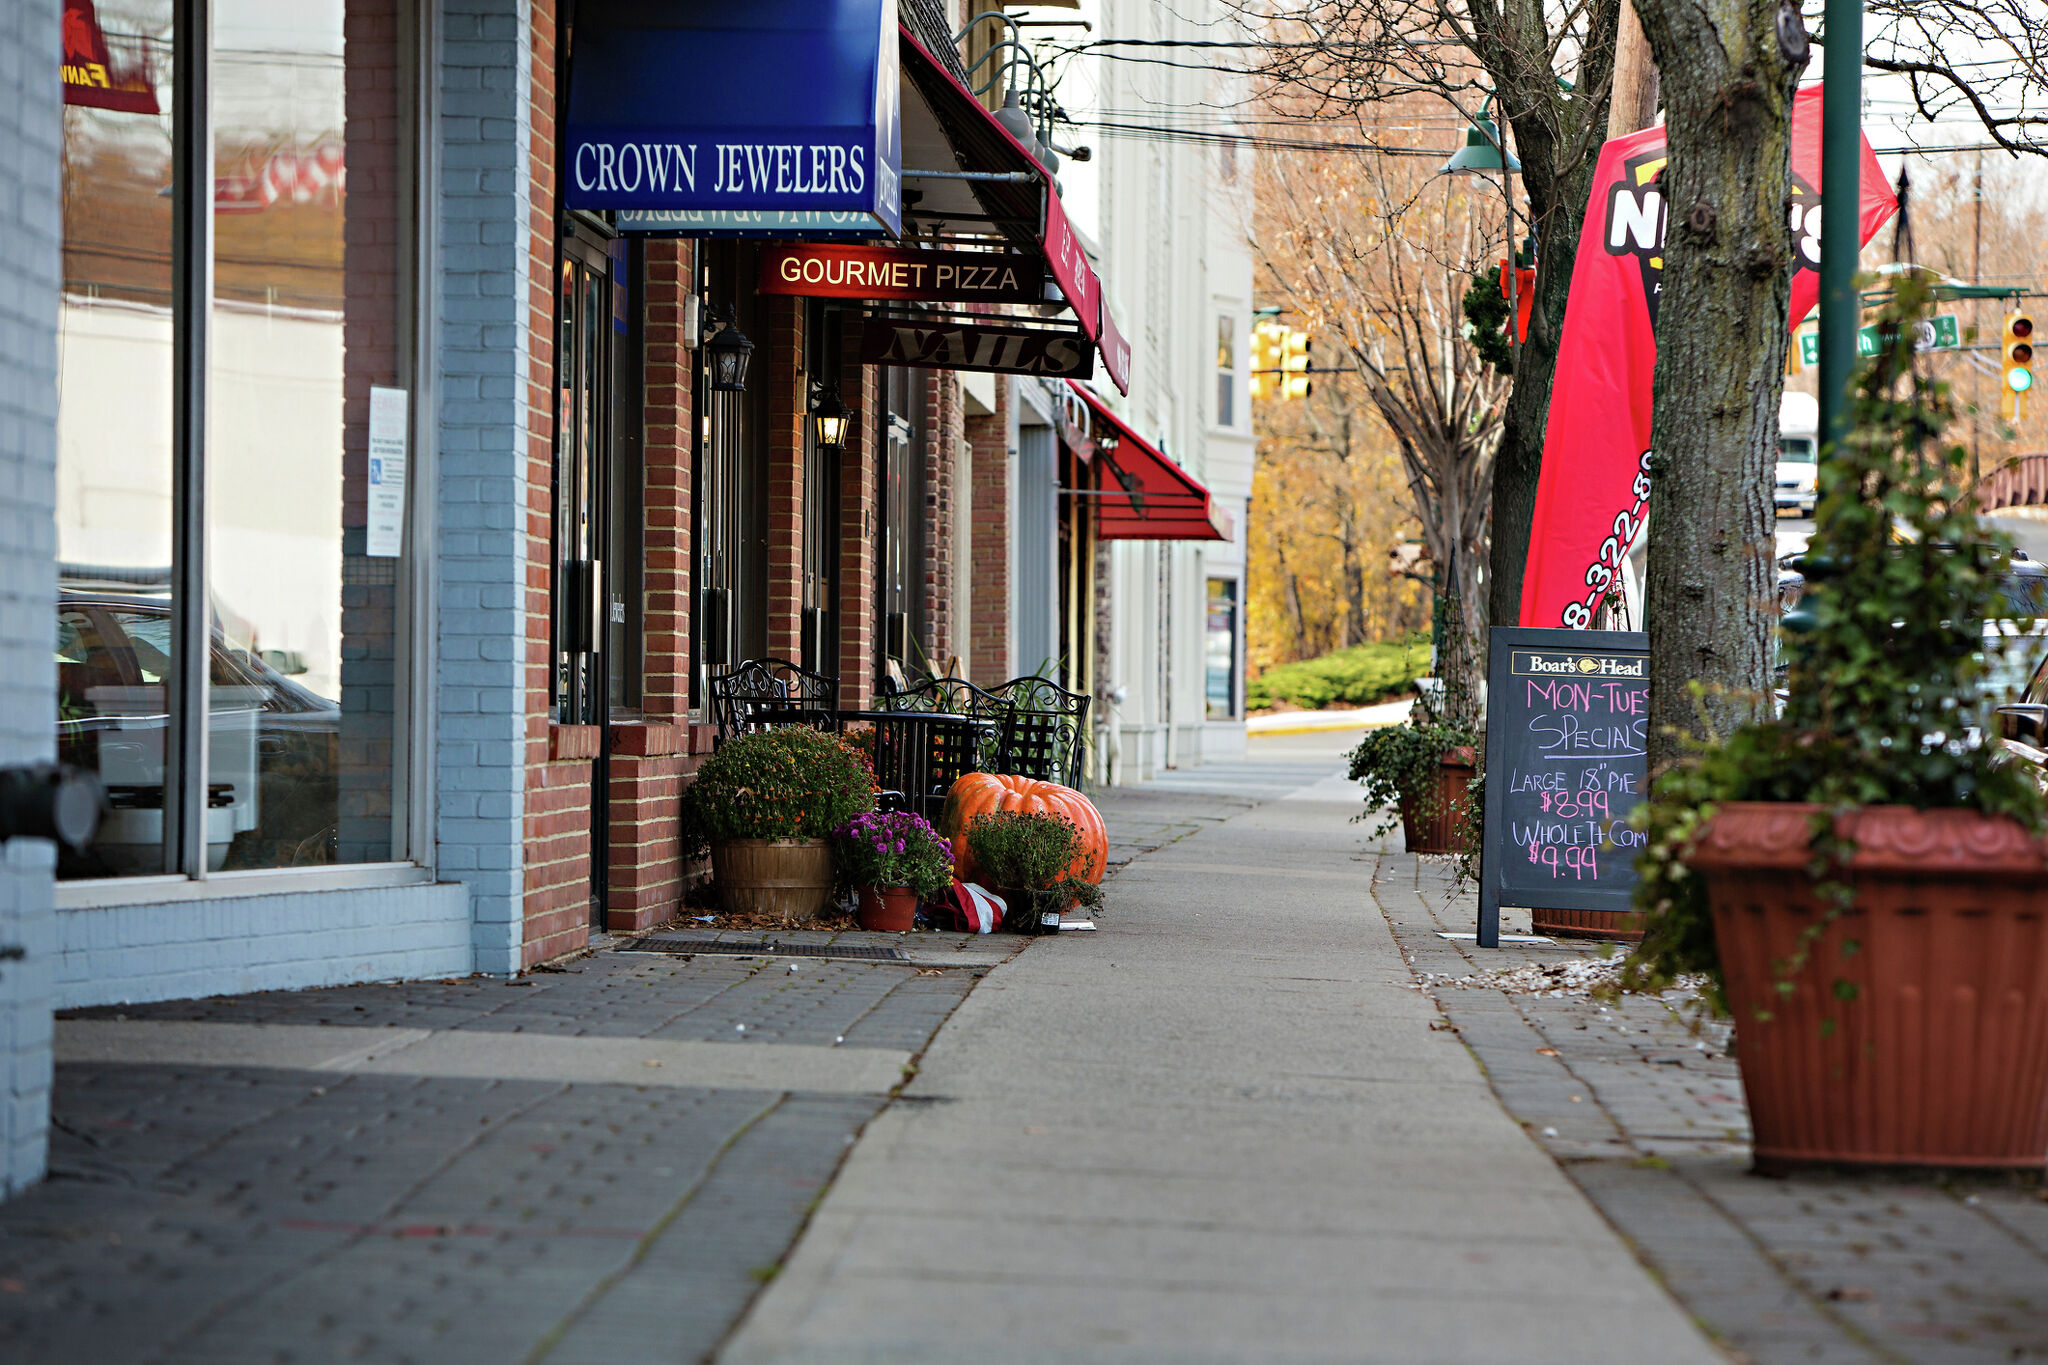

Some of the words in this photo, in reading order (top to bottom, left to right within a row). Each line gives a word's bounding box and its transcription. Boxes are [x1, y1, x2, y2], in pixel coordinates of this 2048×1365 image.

[575, 142, 697, 193] CROWN
[714, 144, 865, 194] JEWELERS
[780, 256, 928, 288] GOURMET
[935, 264, 1019, 290] PIZZA
[878, 326, 1083, 373] NAILS
[1529, 655, 1576, 673] Boar's
[1599, 658, 1643, 676] Head
[1510, 768, 1568, 794] LARGE
[1608, 771, 1639, 794] PIE
[1540, 790, 1610, 819] $8.99
[1512, 820, 1586, 847] WHOLE
[1608, 820, 1649, 848] COM
[1528, 841, 1598, 880] $9.99
